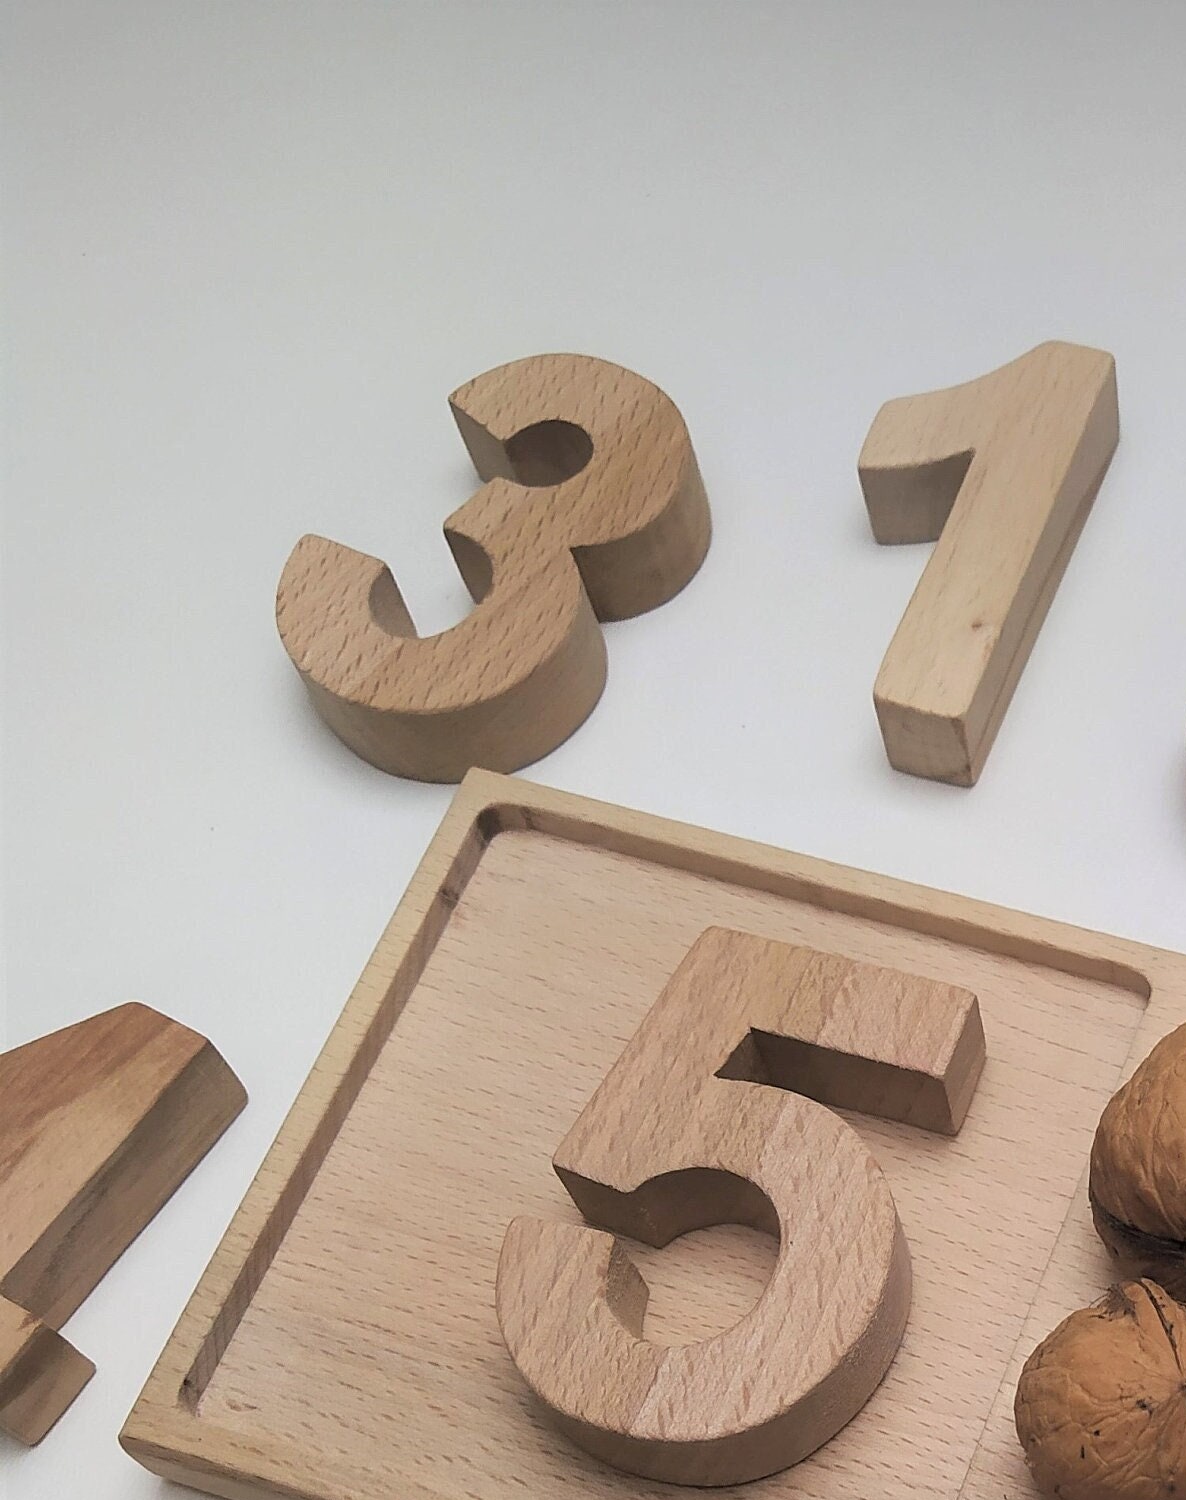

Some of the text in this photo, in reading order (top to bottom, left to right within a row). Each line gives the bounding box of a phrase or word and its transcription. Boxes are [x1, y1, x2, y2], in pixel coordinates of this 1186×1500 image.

[275, 352, 711, 784] 3
[858, 340, 1120, 787] 1
[496, 926, 988, 1486] 5
